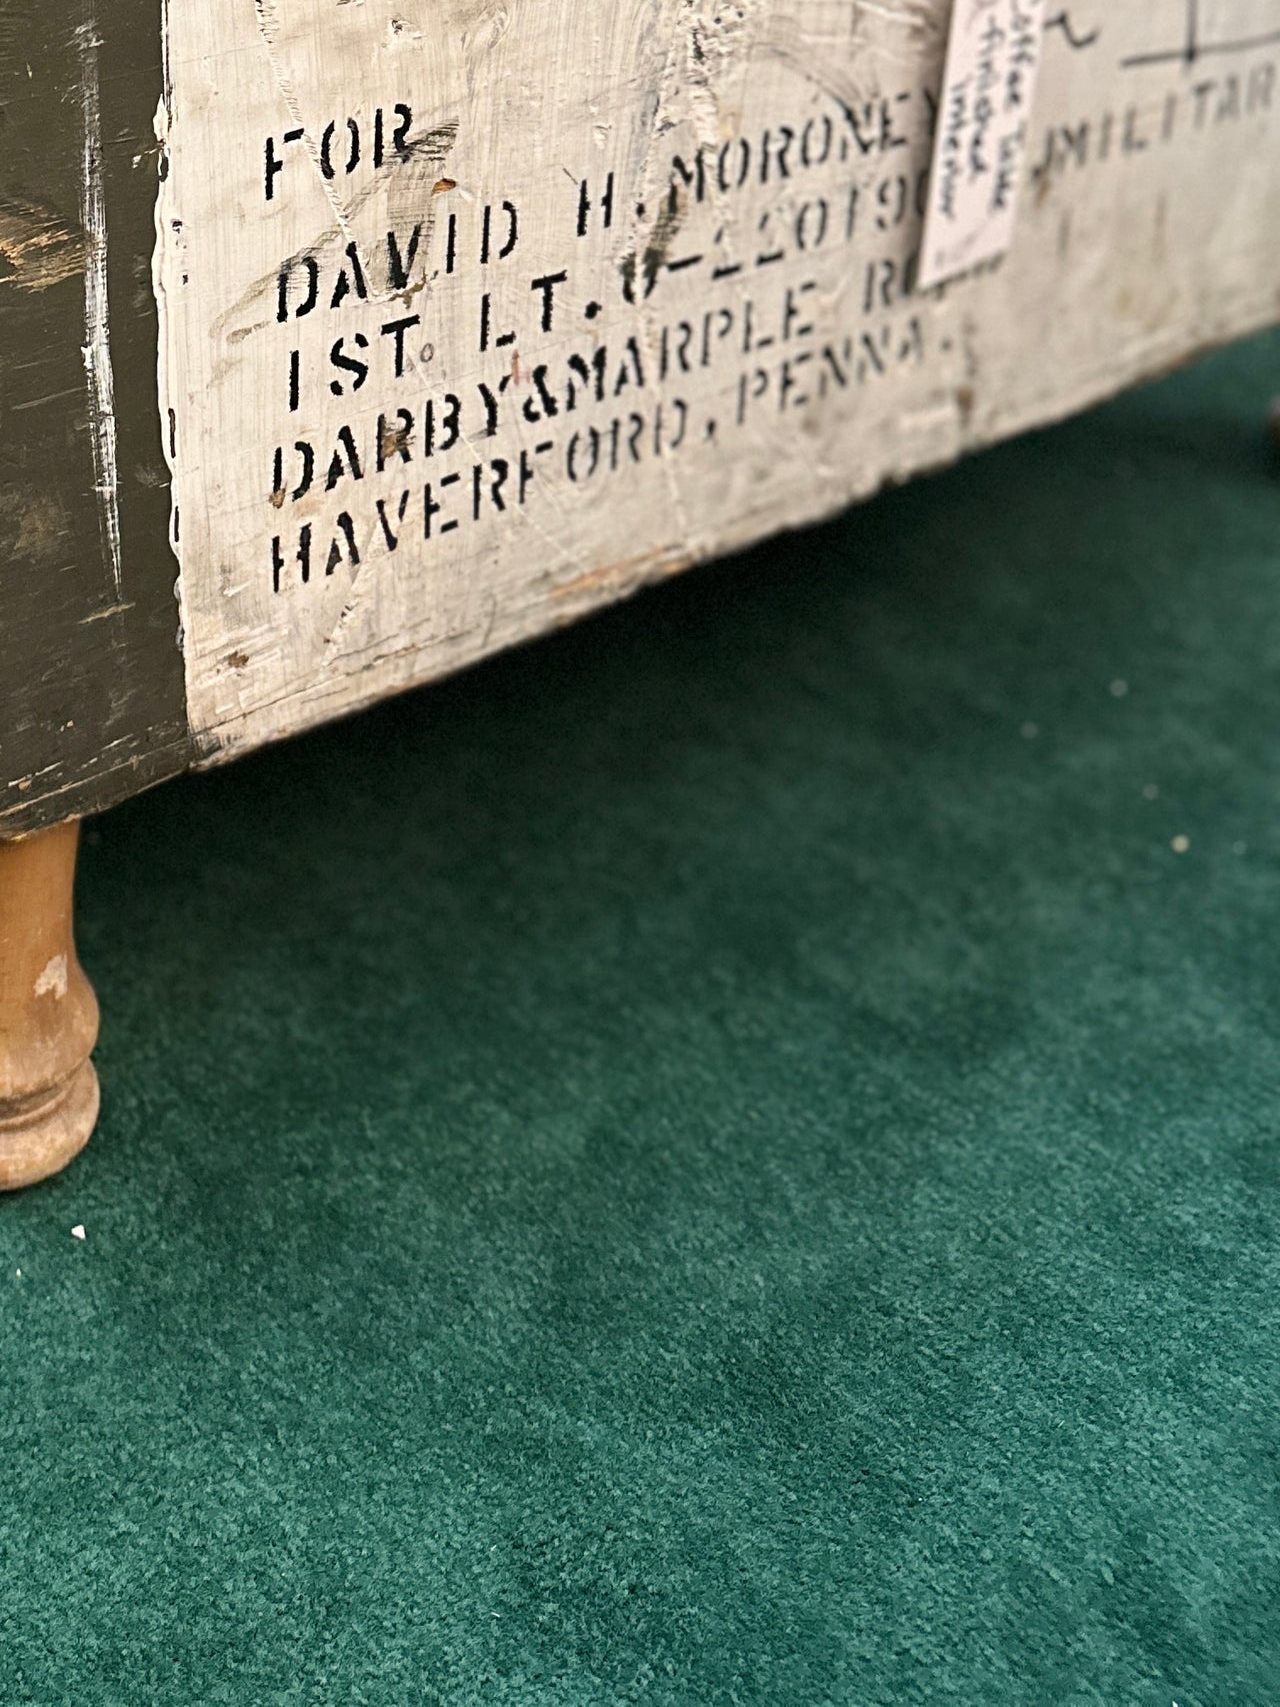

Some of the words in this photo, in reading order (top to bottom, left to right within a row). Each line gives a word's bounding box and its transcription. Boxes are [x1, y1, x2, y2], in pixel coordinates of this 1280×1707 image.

[264, 103, 413, 201] FOR
[276, 200, 519, 323] DAVID
[577, 172, 645, 237] H.
[480, 269, 603, 352] LT.
[271, 281, 817, 501] DARBY&MARPLE
[736, 316, 952, 426] PENNA.
